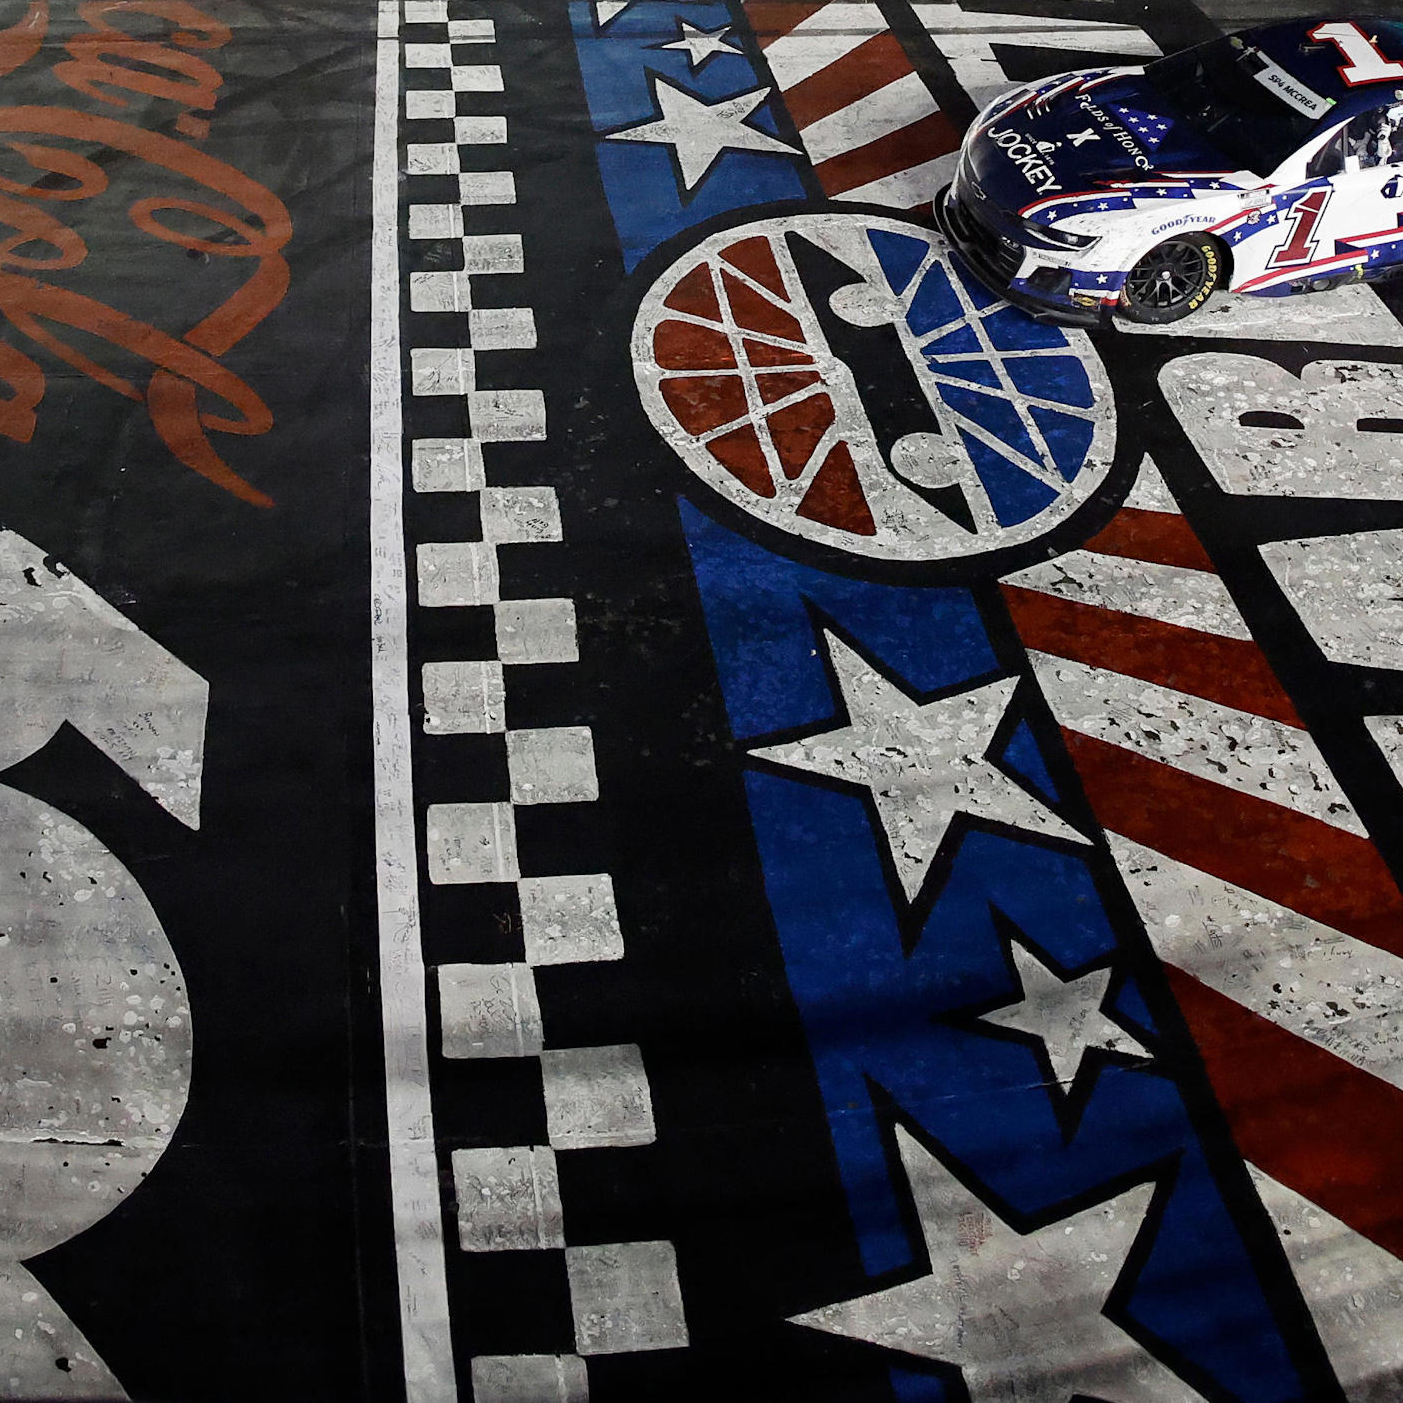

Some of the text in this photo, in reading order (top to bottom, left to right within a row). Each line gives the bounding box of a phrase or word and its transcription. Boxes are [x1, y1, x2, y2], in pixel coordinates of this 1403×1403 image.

[1282, 84, 1318, 112] MCCREA
[986, 126, 1063, 196] JOCKEY
[1066, 127, 1101, 148] X
[1151, 213, 1217, 236] GOODYEAR
[1264, 184, 1334, 270] 1
[1188, 244, 1218, 310] GOODYEAR
